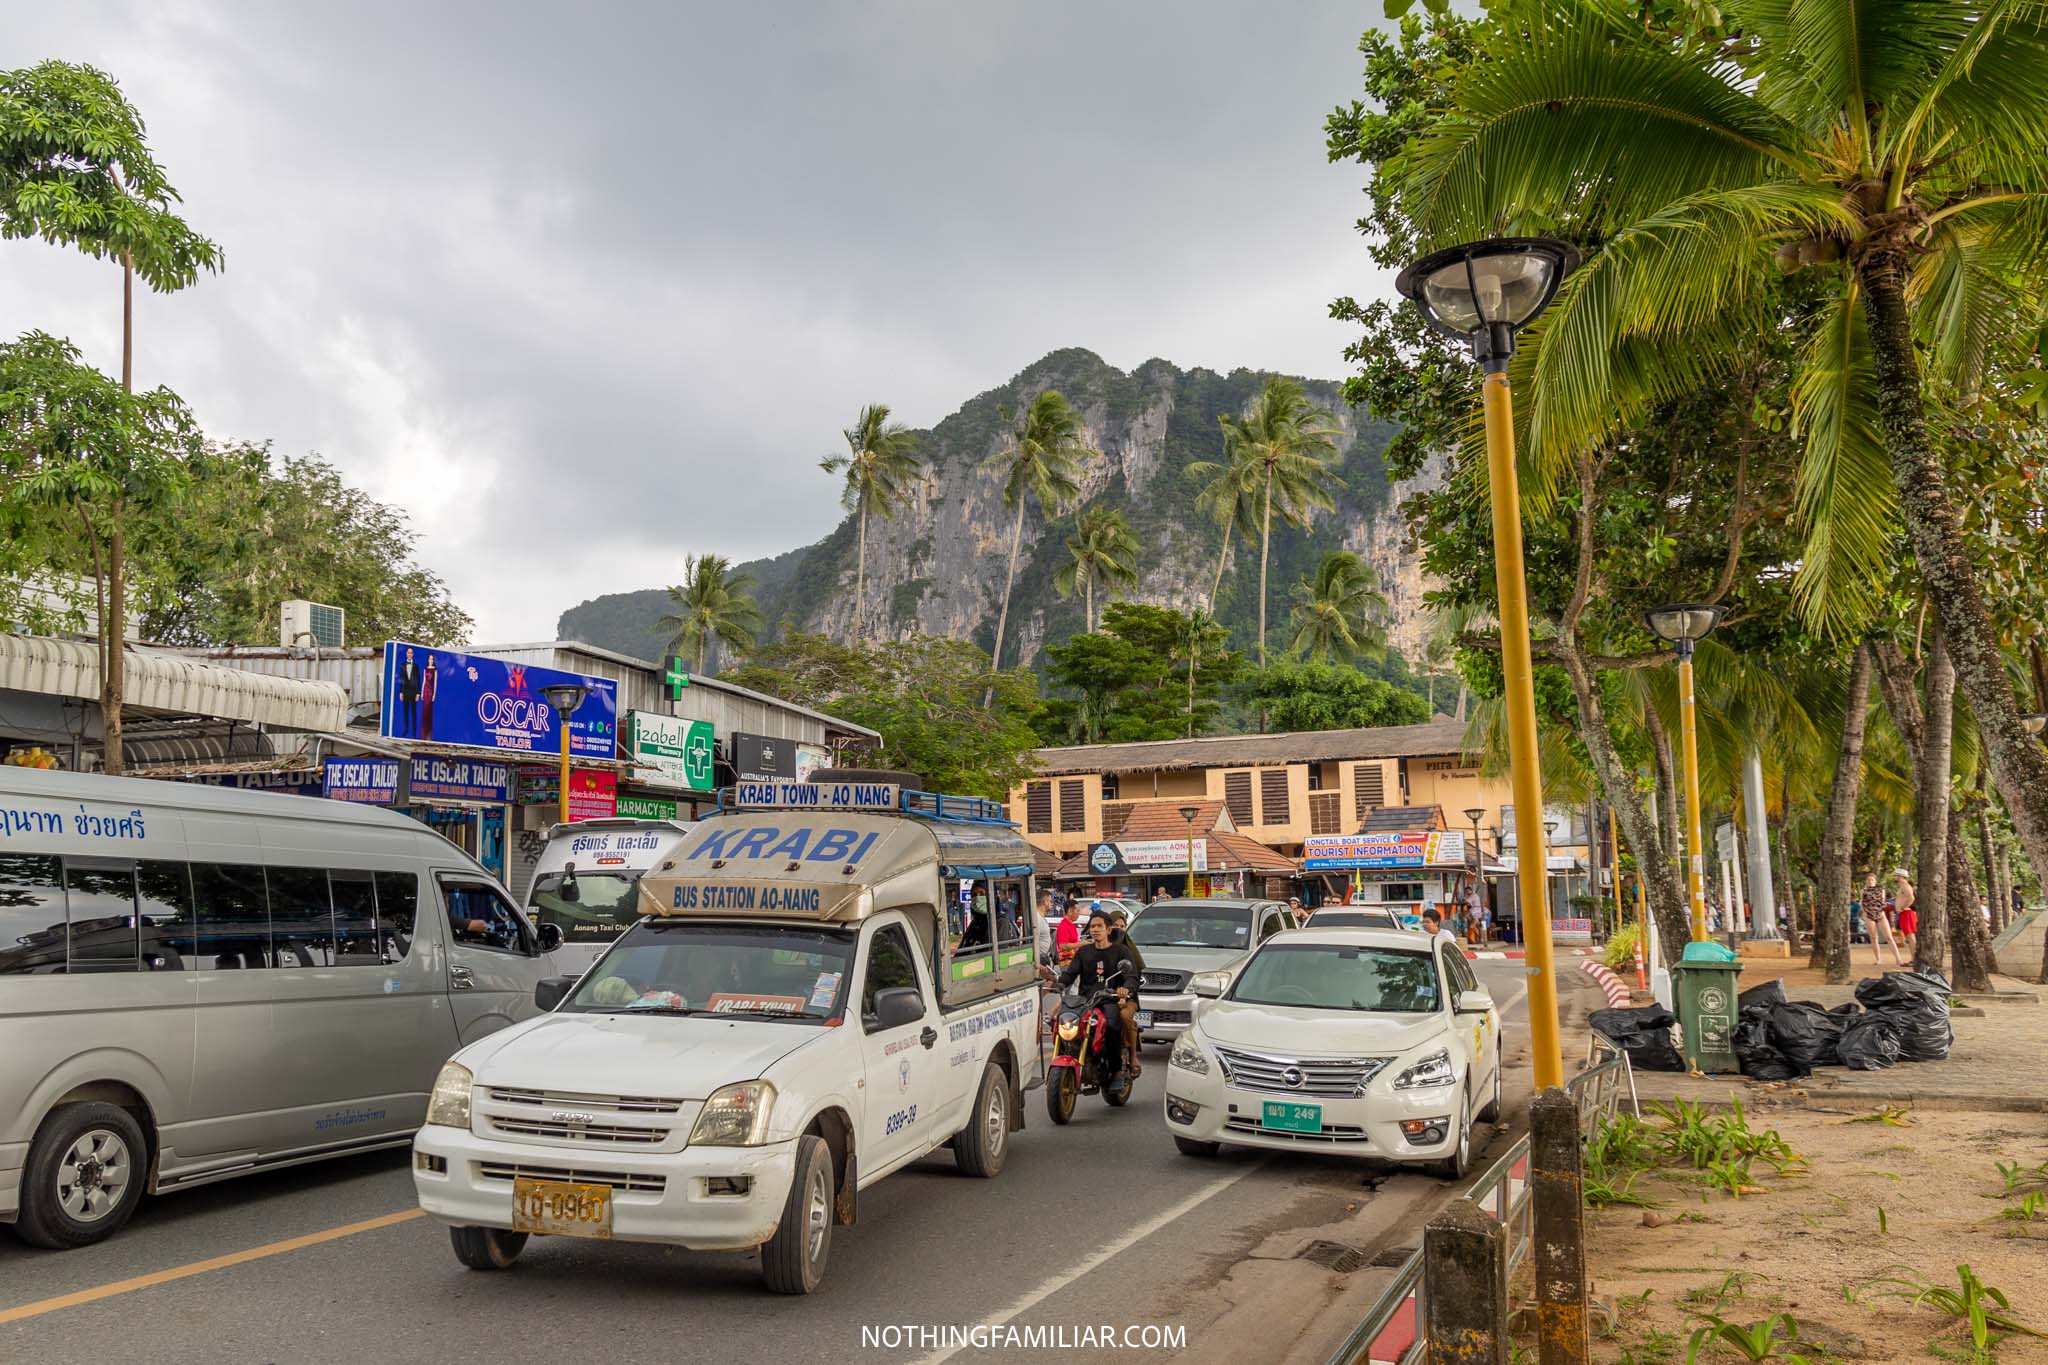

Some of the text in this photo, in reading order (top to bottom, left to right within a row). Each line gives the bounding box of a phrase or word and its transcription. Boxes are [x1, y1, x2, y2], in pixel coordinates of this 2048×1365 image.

[478, 692, 550, 732] OSCAR
[496, 736, 532, 749] TAILOR
[636, 718, 684, 747] izabell
[657, 746, 682, 758] Pharmacy
[327, 764, 399, 788] THE OSCAR TAILOR
[432, 759, 469, 785] OSCAR
[472, 765, 507, 788] TAILOR
[739, 785, 776, 805] KRABI
[781, 786, 818, 805] TOWN
[855, 786, 891, 806] NANG
[75, 804, 145, 839] ช่วยศรี
[572, 834, 610, 855] สุรินทร์
[687, 827, 880, 865] KRABI
[1306, 838, 1339, 846] LONGTAIL
[1342, 837, 1361, 845] BOAT
[1363, 836, 1393, 844] SERVICE
[1309, 844, 1422, 857] TOURIST INFORMATION
[673, 886, 820, 911] BUS STATION AO-NANG
[574, 924, 598, 933] Aonang
[551, 1111, 594, 1124] ISUZU
[886, 1104, 917, 1136] 8399-39
[1294, 1107, 1314, 1120] 249
